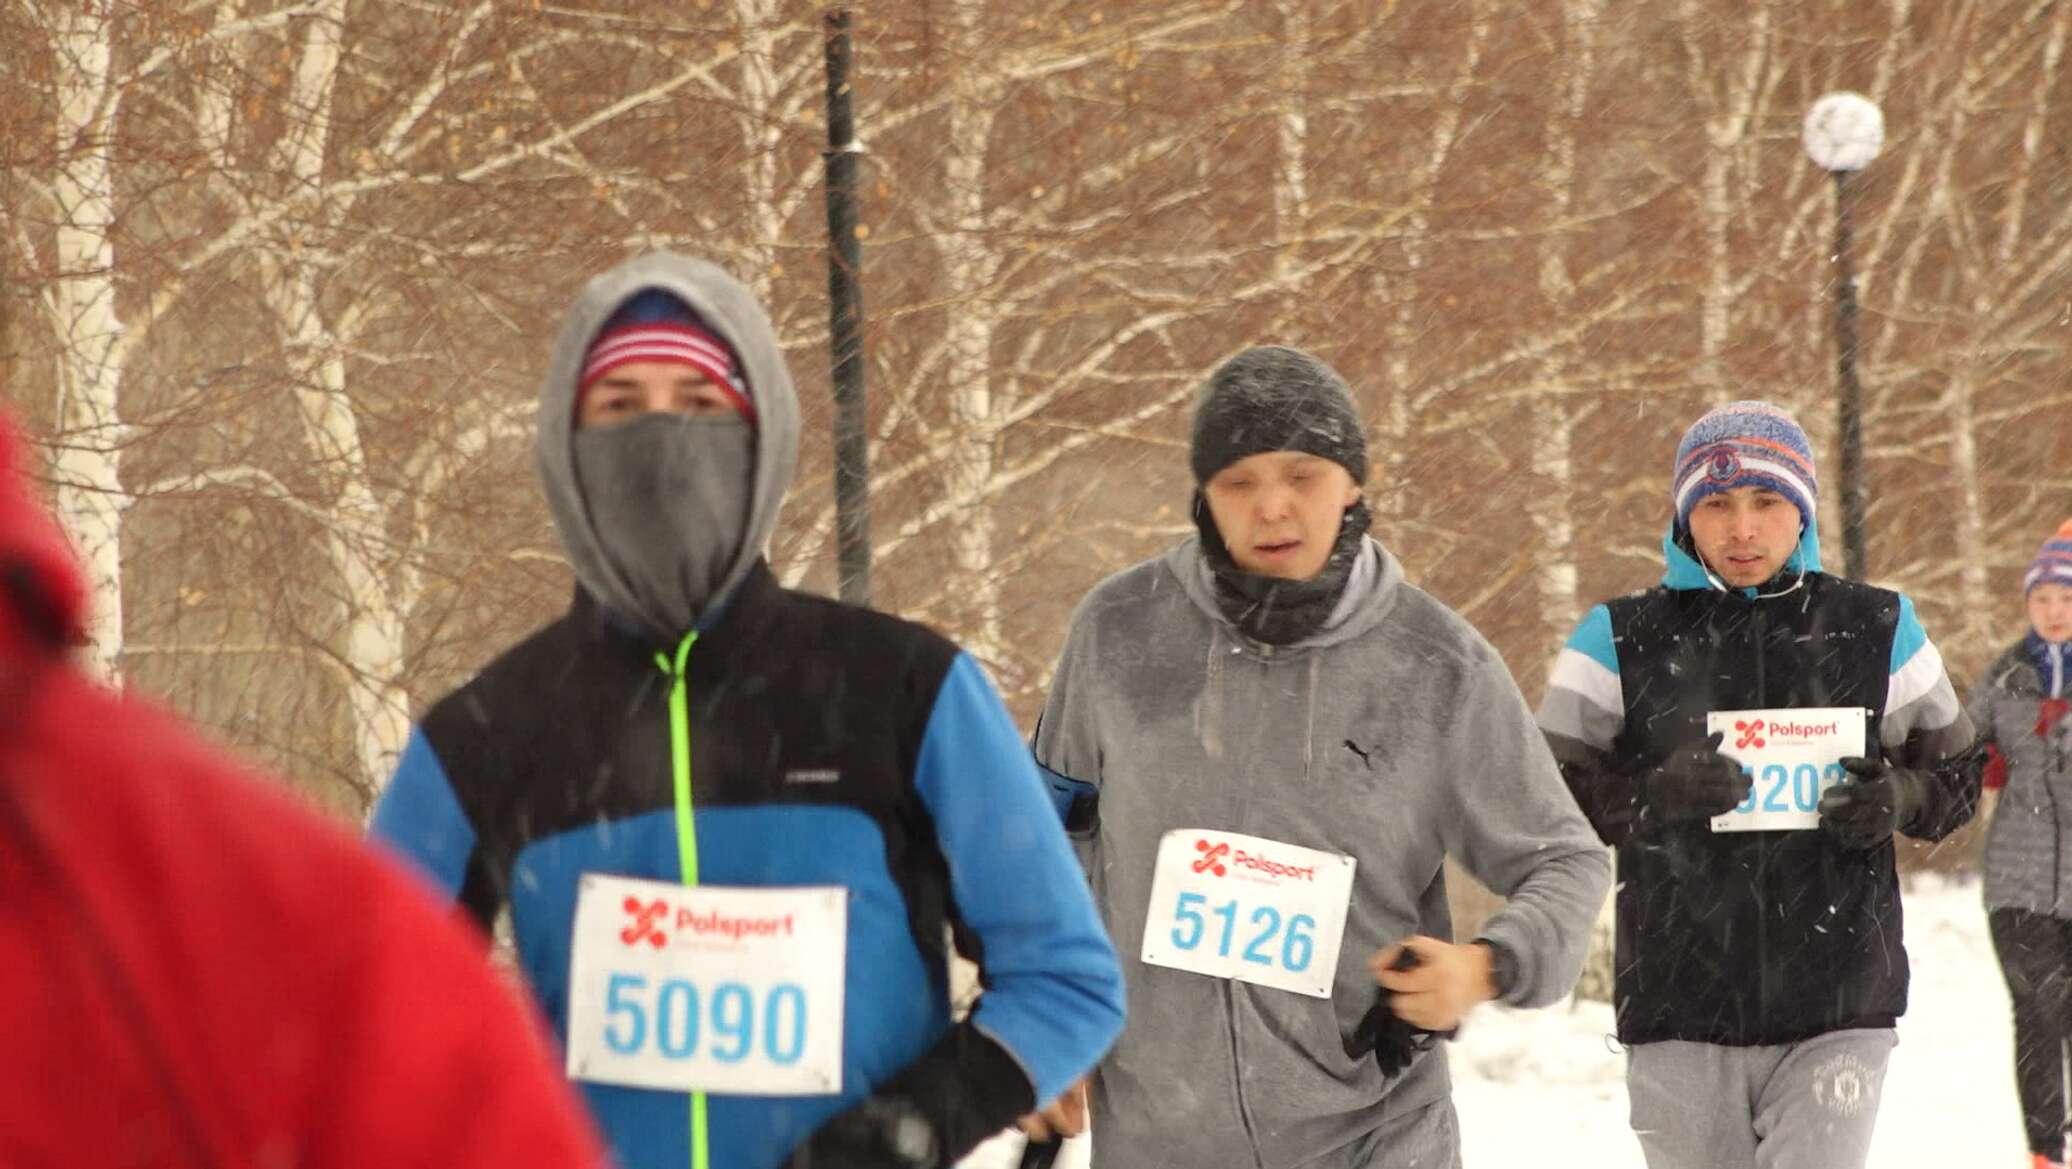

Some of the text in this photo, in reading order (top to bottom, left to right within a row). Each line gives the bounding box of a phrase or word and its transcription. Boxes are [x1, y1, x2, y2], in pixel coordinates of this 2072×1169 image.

[1769, 721, 1838, 738] Polsport
[1233, 850, 1315, 881] Polsport
[676, 907, 794, 938] Polsport
[1171, 891, 1316, 973] 5126
[605, 972, 807, 1066] 5090
